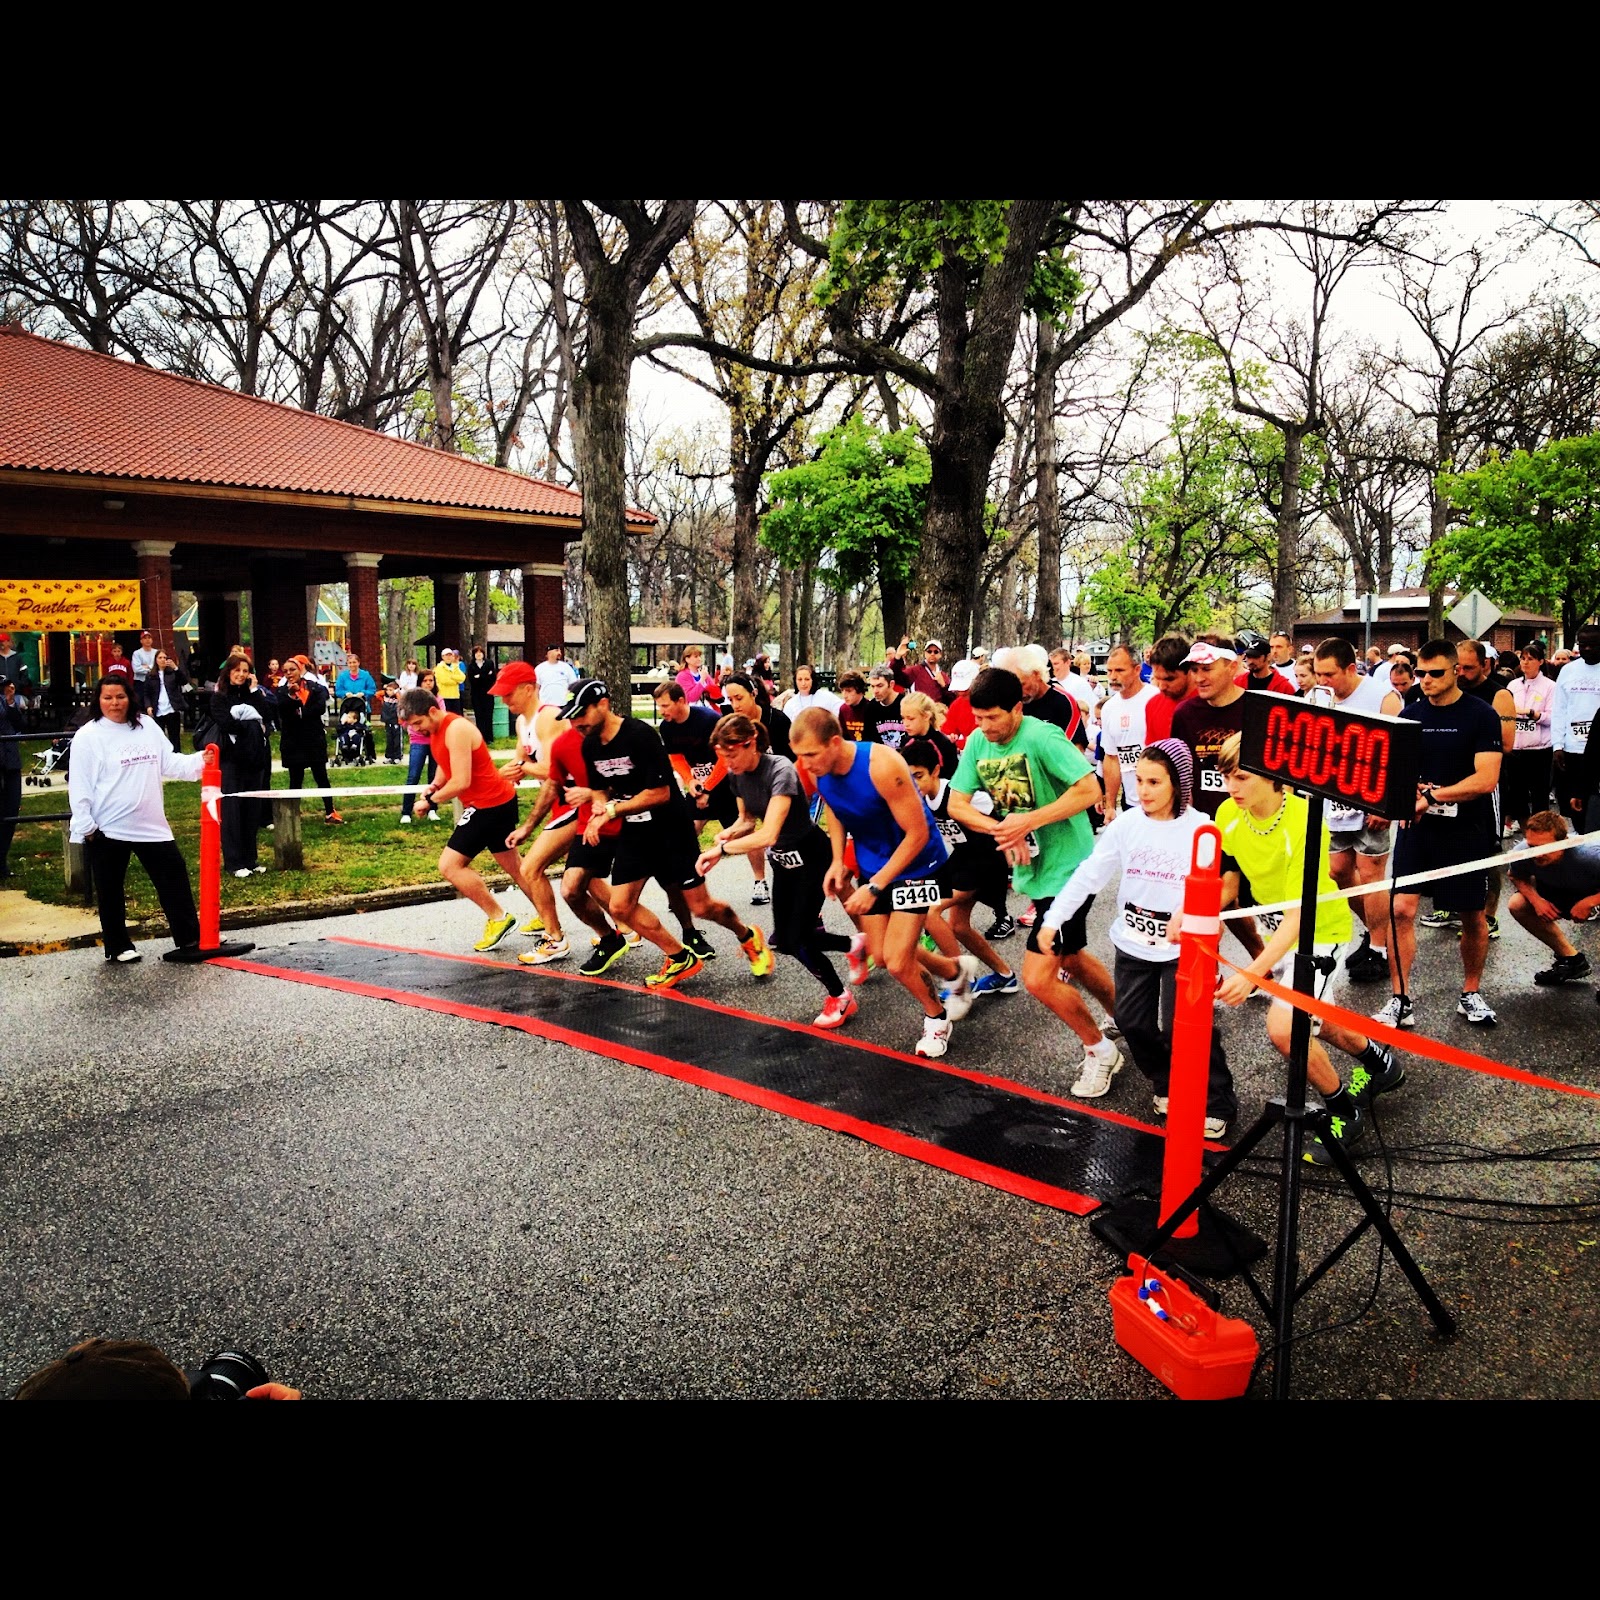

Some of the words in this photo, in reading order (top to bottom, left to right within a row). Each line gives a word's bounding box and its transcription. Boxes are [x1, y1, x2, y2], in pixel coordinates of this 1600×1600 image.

[94, 597, 136, 613] Run!
[1263, 705, 1390, 803] 0:00:00
[1204, 772, 1223, 788] 55
[896, 886, 938, 906] 5440
[1125, 913, 1168, 938] 5595
